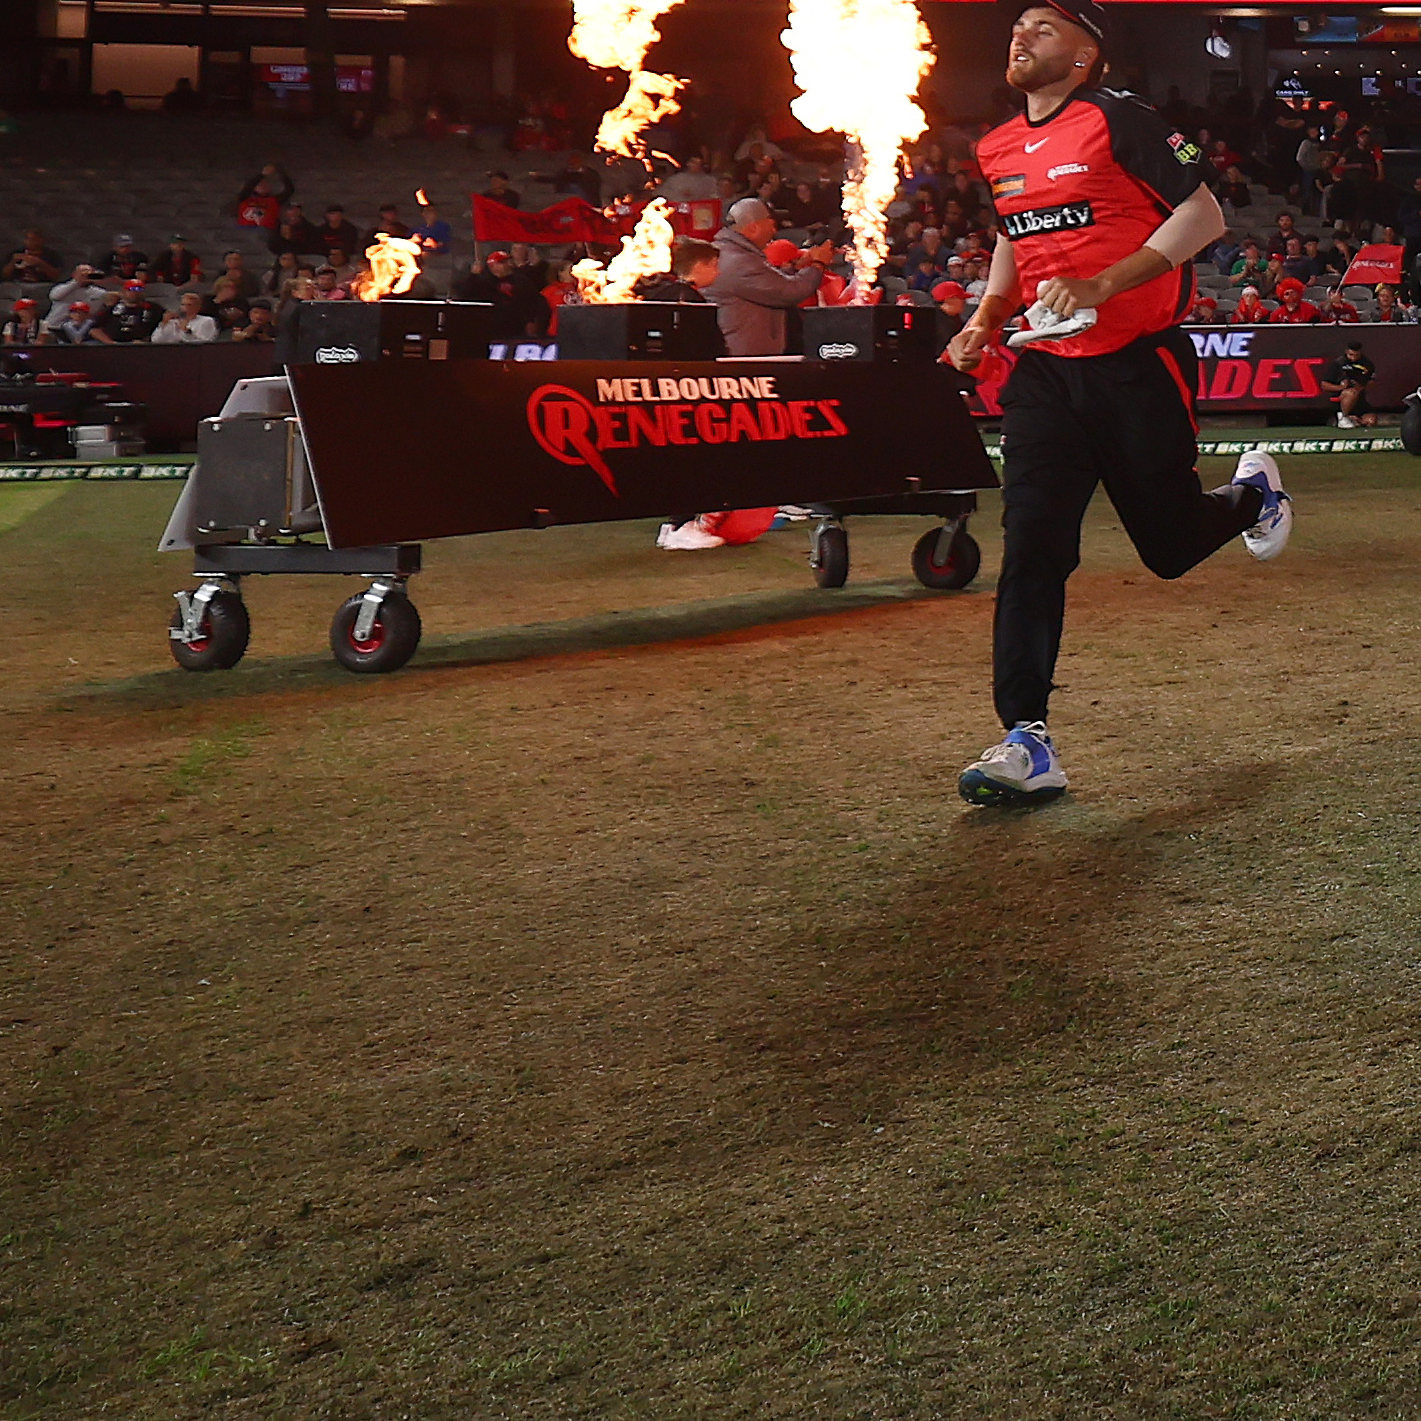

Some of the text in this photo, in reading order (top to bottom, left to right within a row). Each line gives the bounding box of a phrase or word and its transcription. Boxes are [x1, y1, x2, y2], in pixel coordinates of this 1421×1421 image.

[1014, 204, 1091, 237] Liberty
[596, 376, 780, 402] MELBOURNE
[526, 382, 848, 498] RENEGADES
[1216, 441, 1254, 454] BKT
[1256, 440, 1292, 454] BKT
[1294, 439, 1330, 453] BKT
[1332, 438, 1368, 452] BKT
[39, 467, 87, 480] BKT
[89, 466, 138, 479] BKT
[141, 465, 189, 478] BKT
